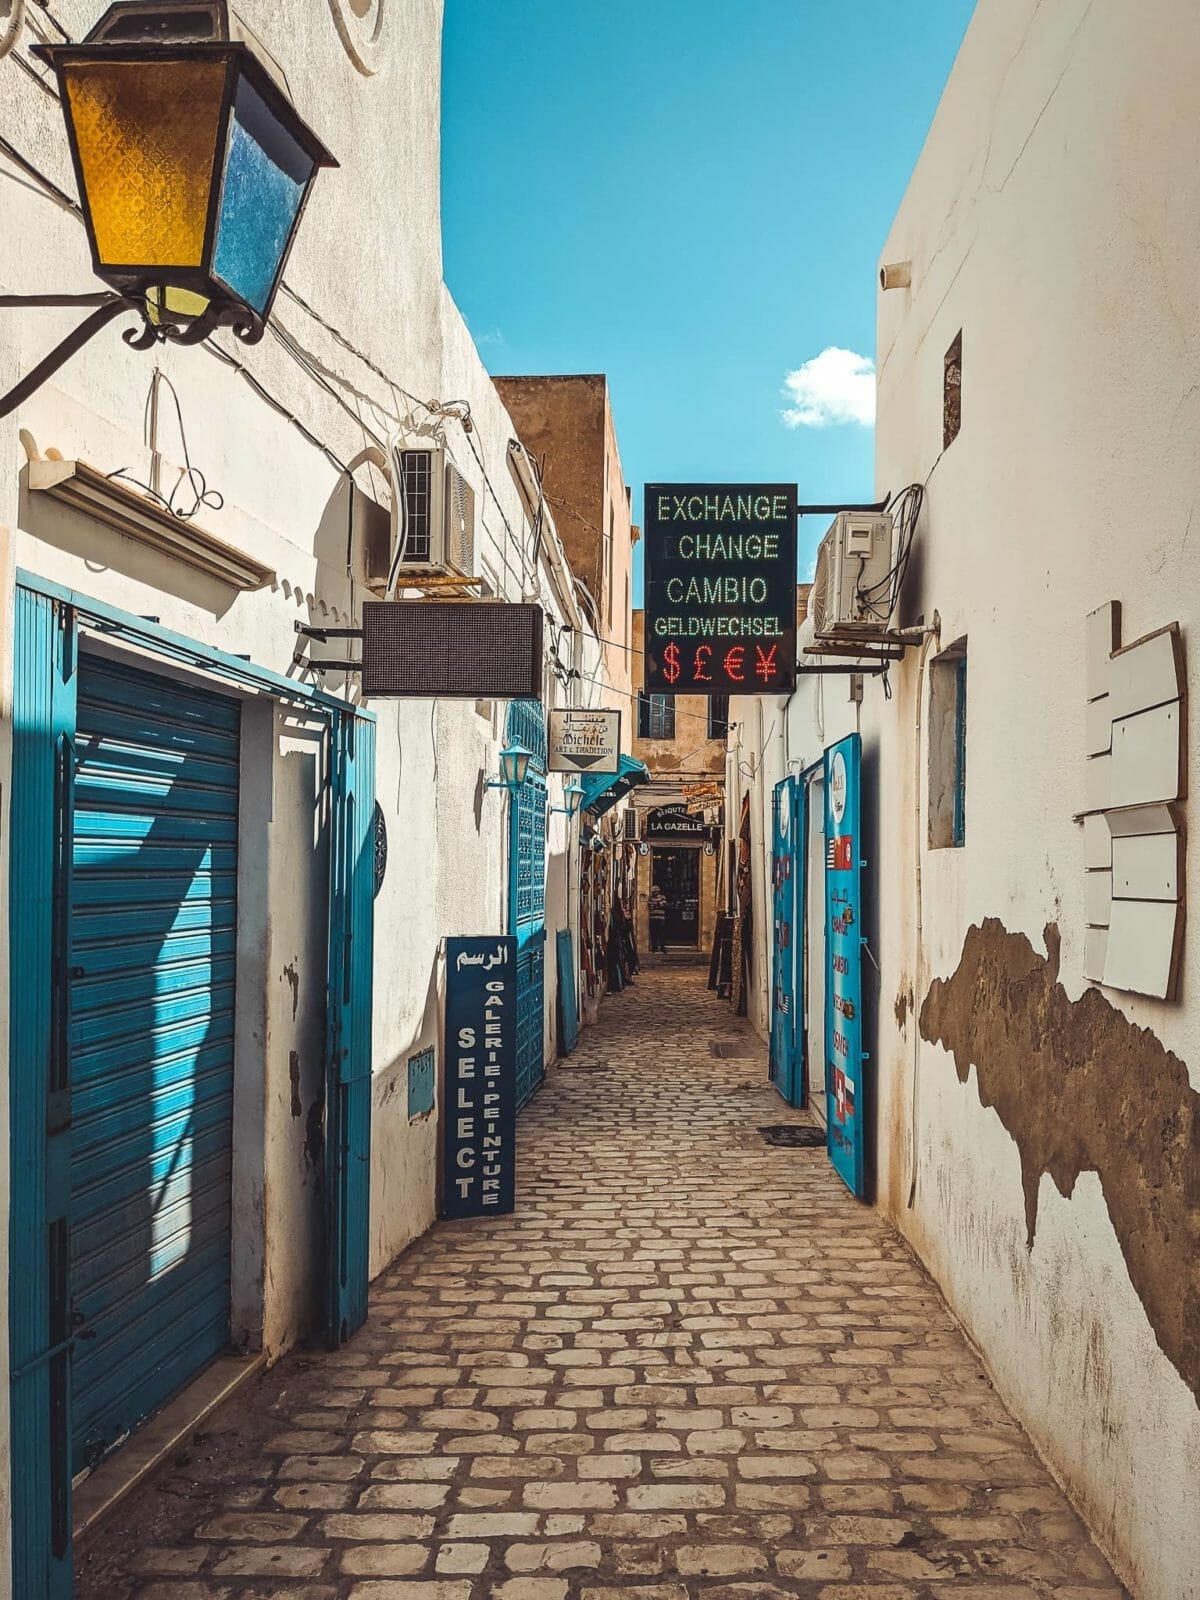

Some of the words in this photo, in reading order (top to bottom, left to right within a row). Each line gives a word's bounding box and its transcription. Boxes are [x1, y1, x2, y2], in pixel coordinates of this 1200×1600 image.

[657, 495, 788, 521] EXCHANGE
[679, 534, 779, 560] CHANGE
[666, 576, 767, 604] CAMBIO
[654, 617, 784, 636] GELDWECHSEL
[663, 642, 681, 684] $
[723, 646, 745, 680] €
[575, 746, 614, 754] TRADITION
[651, 822, 663, 831] LA
[664, 822, 703, 831] GAZELLE
[457, 945, 508, 971] الرسم
[456, 1027, 476, 1199] SELECT
